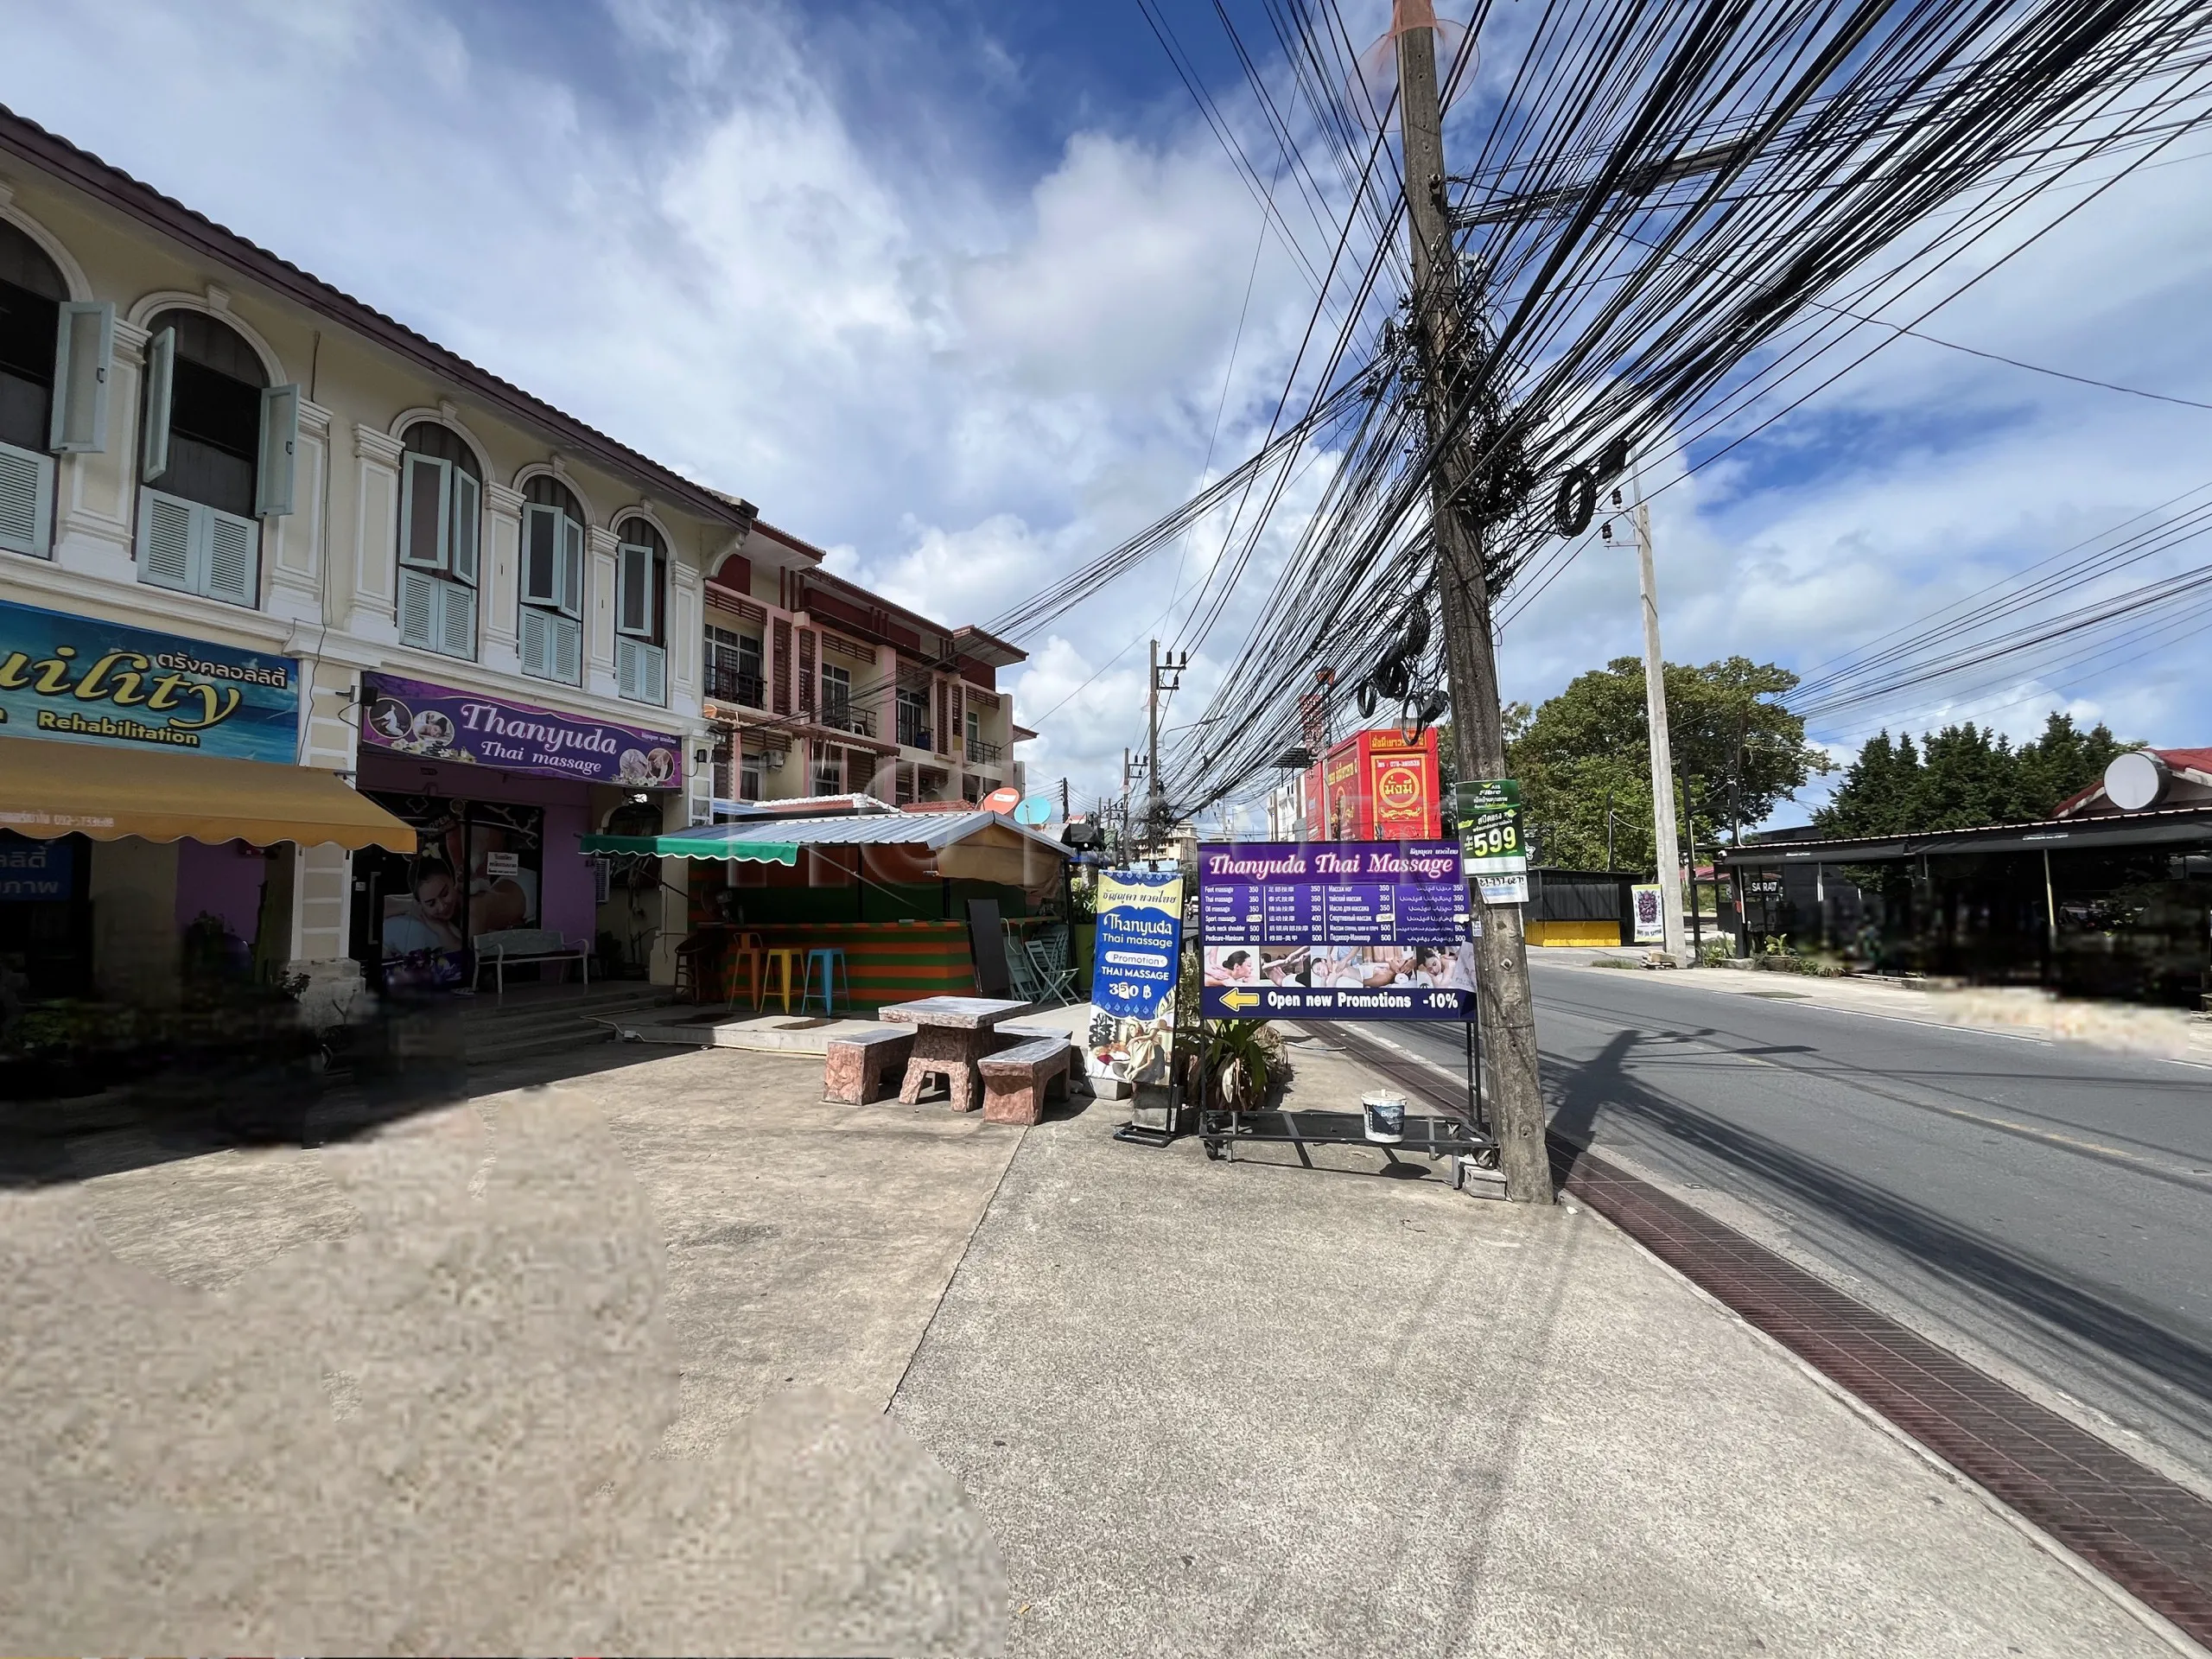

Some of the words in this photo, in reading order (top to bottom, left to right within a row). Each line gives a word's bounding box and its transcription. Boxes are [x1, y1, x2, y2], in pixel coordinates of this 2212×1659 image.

[39, 710, 199, 746] Rehabilitation
[461, 703, 617, 754] Thanyuda
[481, 741, 524, 760] Thai
[532, 753, 601, 775] massage
[1473, 826, 1516, 857] 599
[1209, 853, 1306, 880] Thanyuda
[1315, 851, 1359, 874] Thai
[1367, 852, 1453, 880] Massage
[1103, 912, 1173, 936] Thanyuda
[1102, 932, 1124, 944] Thai
[1127, 935, 1173, 949] massage
[1113, 954, 1160, 965] Promotion
[1102, 966, 1122, 976] THAI
[1125, 969, 1169, 981] MASSAGE
[1268, 992, 1300, 1009] Open
[1306, 995, 1332, 1007] new
[1338, 991, 1412, 1008] Promotions
[1423, 993, 1459, 1008] -10%
